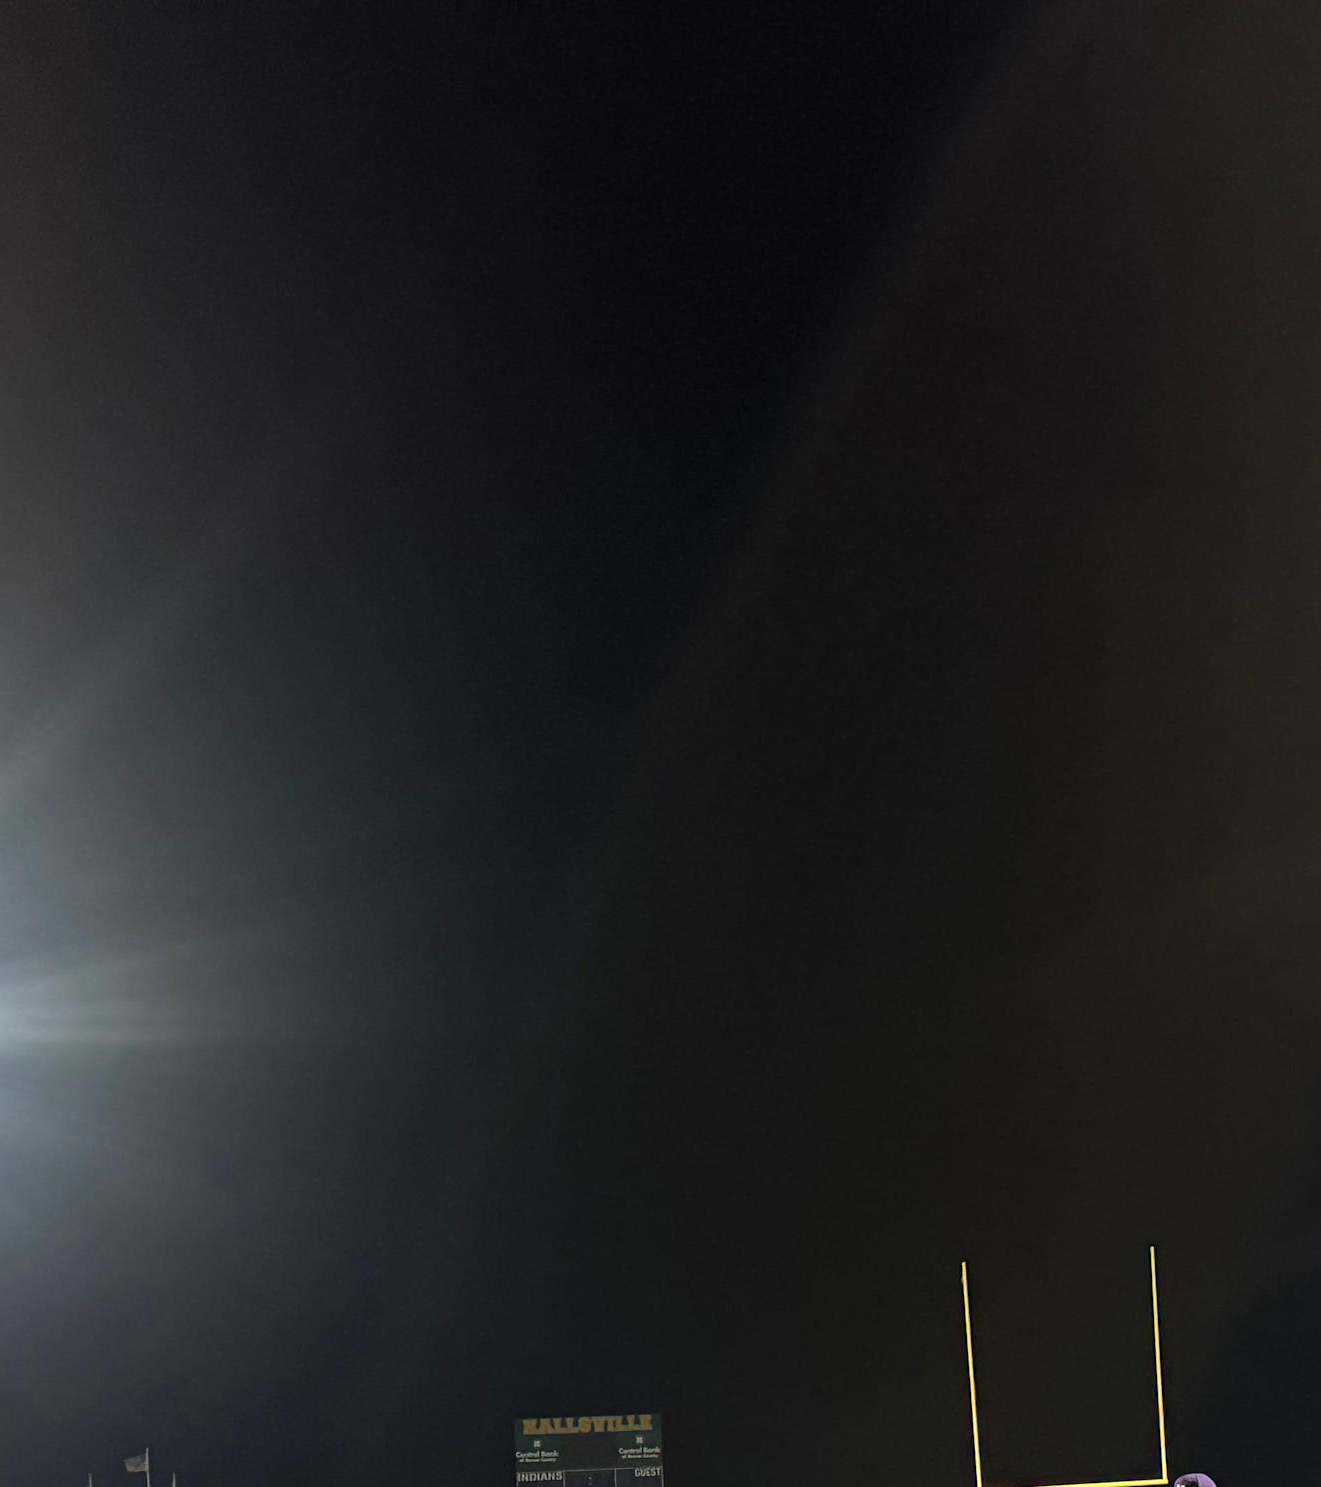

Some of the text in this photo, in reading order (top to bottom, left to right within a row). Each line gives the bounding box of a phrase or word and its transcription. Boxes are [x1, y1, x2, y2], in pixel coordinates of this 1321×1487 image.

[522, 1414, 653, 1436] HALLSVILLE
[517, 1471, 563, 1482] INDIANS
[634, 1466, 662, 1478] GUEST
